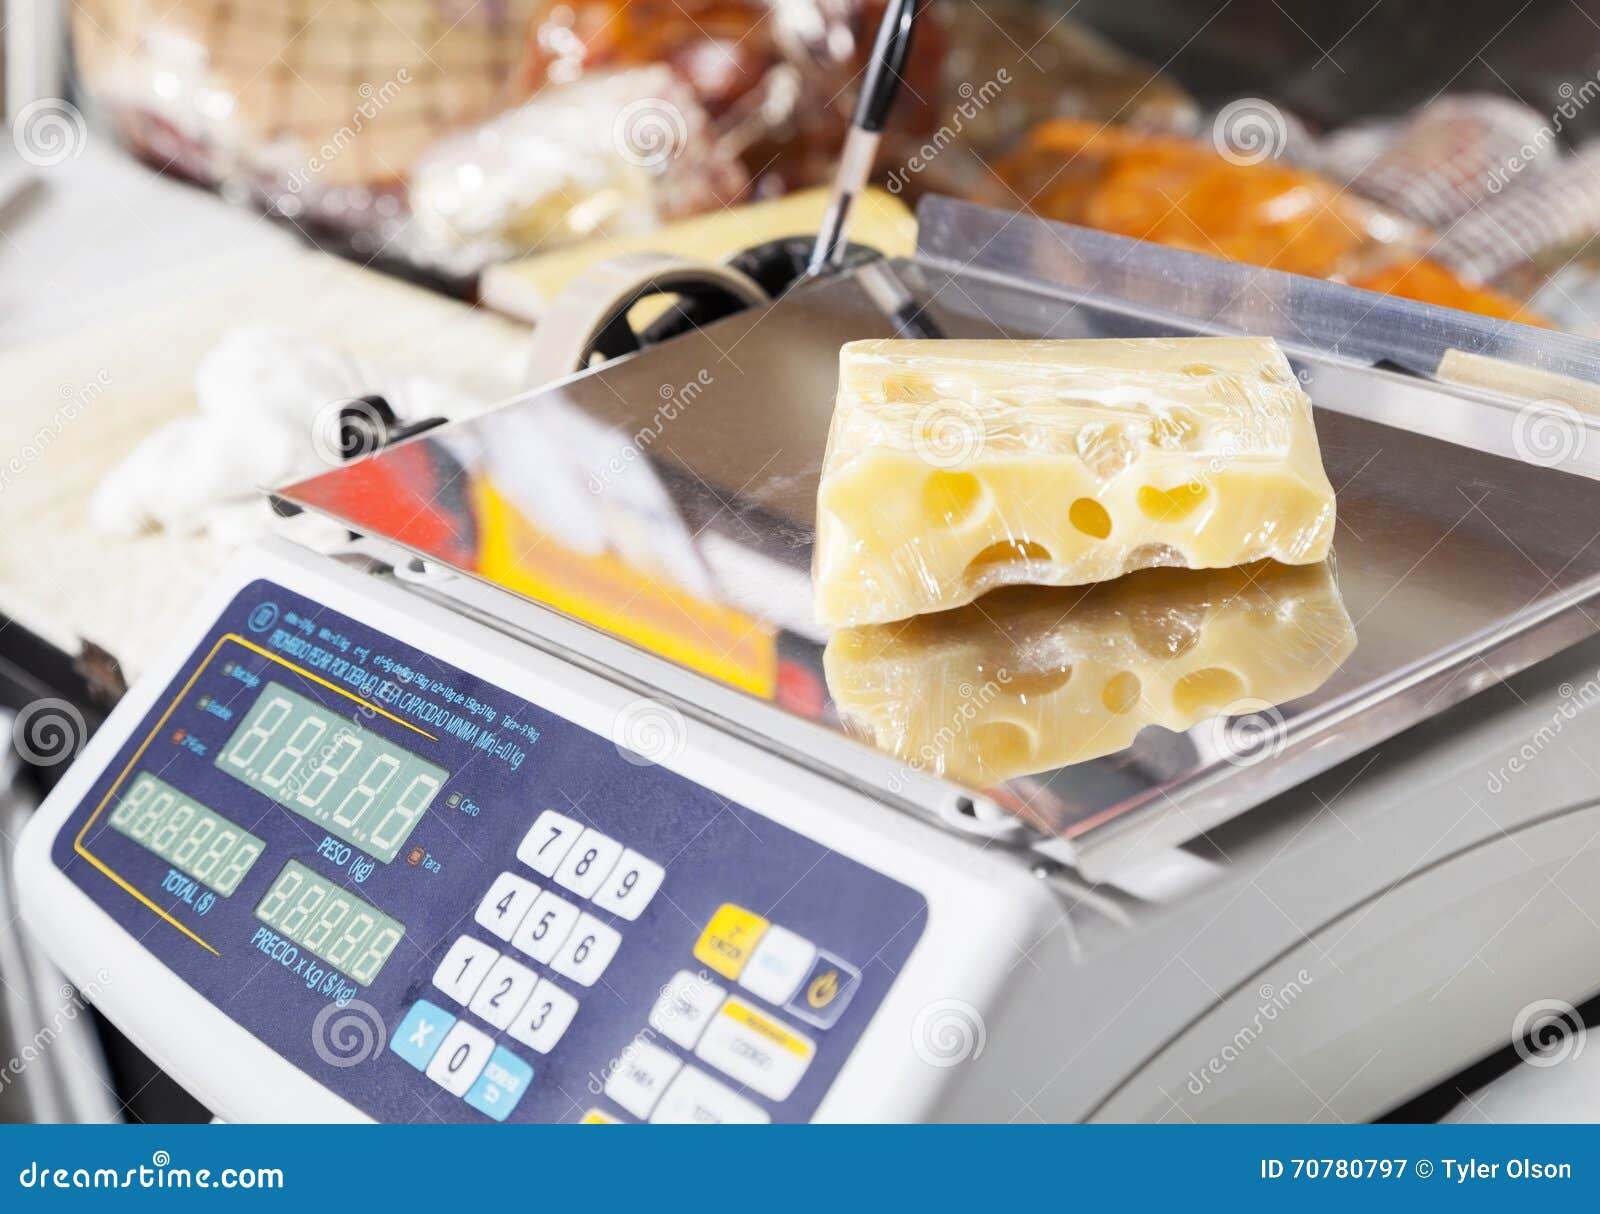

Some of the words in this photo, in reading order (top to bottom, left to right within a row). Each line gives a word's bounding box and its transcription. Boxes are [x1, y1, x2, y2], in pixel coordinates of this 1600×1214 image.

[399, 692, 450, 728] CAPACIDAD
[460, 799, 481, 818] Cero
[316, 836, 352, 866] PESO
[348, 855, 376, 883] (kg)
[421, 853, 442, 875] Tara
[538, 826, 563, 857] 7
[575, 848, 598, 877] 8
[616, 869, 640, 899] 9
[160, 869, 200, 905] TOTAL
[191, 890, 217, 916] ($)
[496, 889, 518, 920] 4
[532, 911, 557, 942] 5
[573, 935, 596, 964] 6
[250, 927, 299, 966] PRECIO
[293, 957, 307, 975] x
[455, 954, 475, 985] 1
[489, 976, 514, 1008] 2
[530, 1001, 553, 1031] 3
[448, 1042, 471, 1073] 0
